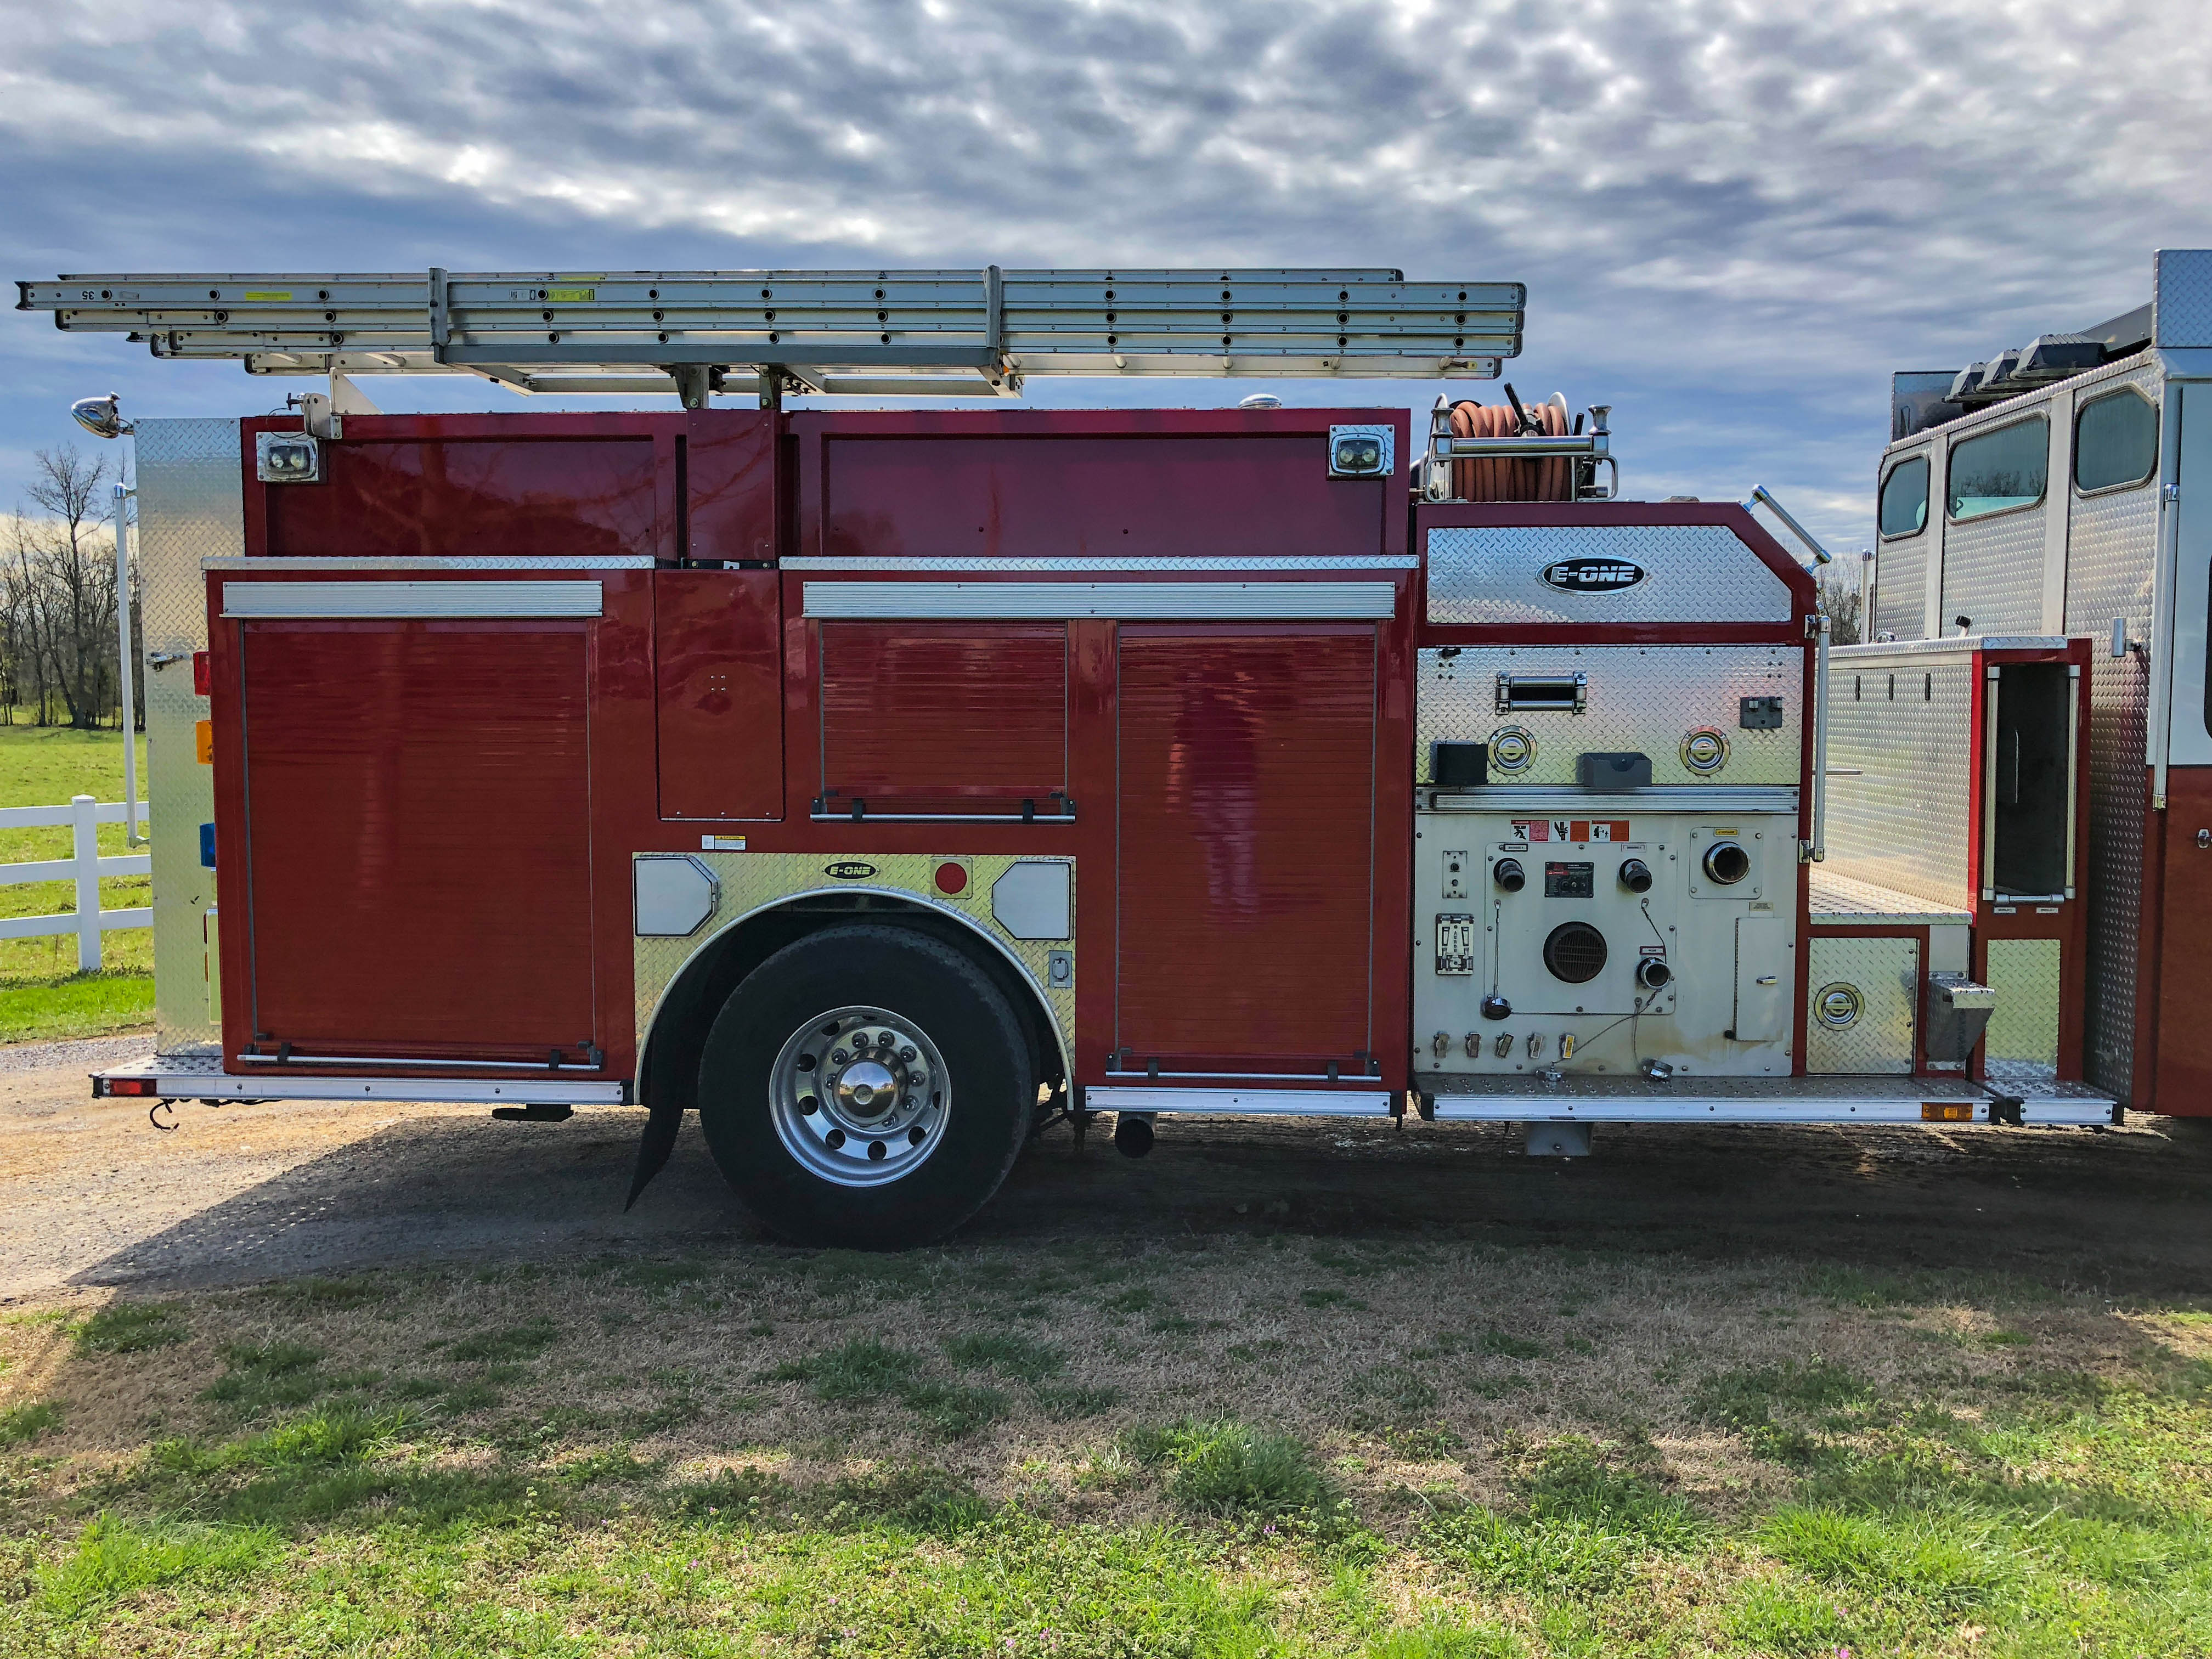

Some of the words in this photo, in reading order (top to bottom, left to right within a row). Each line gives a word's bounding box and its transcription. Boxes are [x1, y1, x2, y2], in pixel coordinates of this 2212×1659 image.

[82, 291, 94, 300] 35
[1549, 566, 1636, 583] E-ONE
[830, 866, 871, 875] E-ONE
